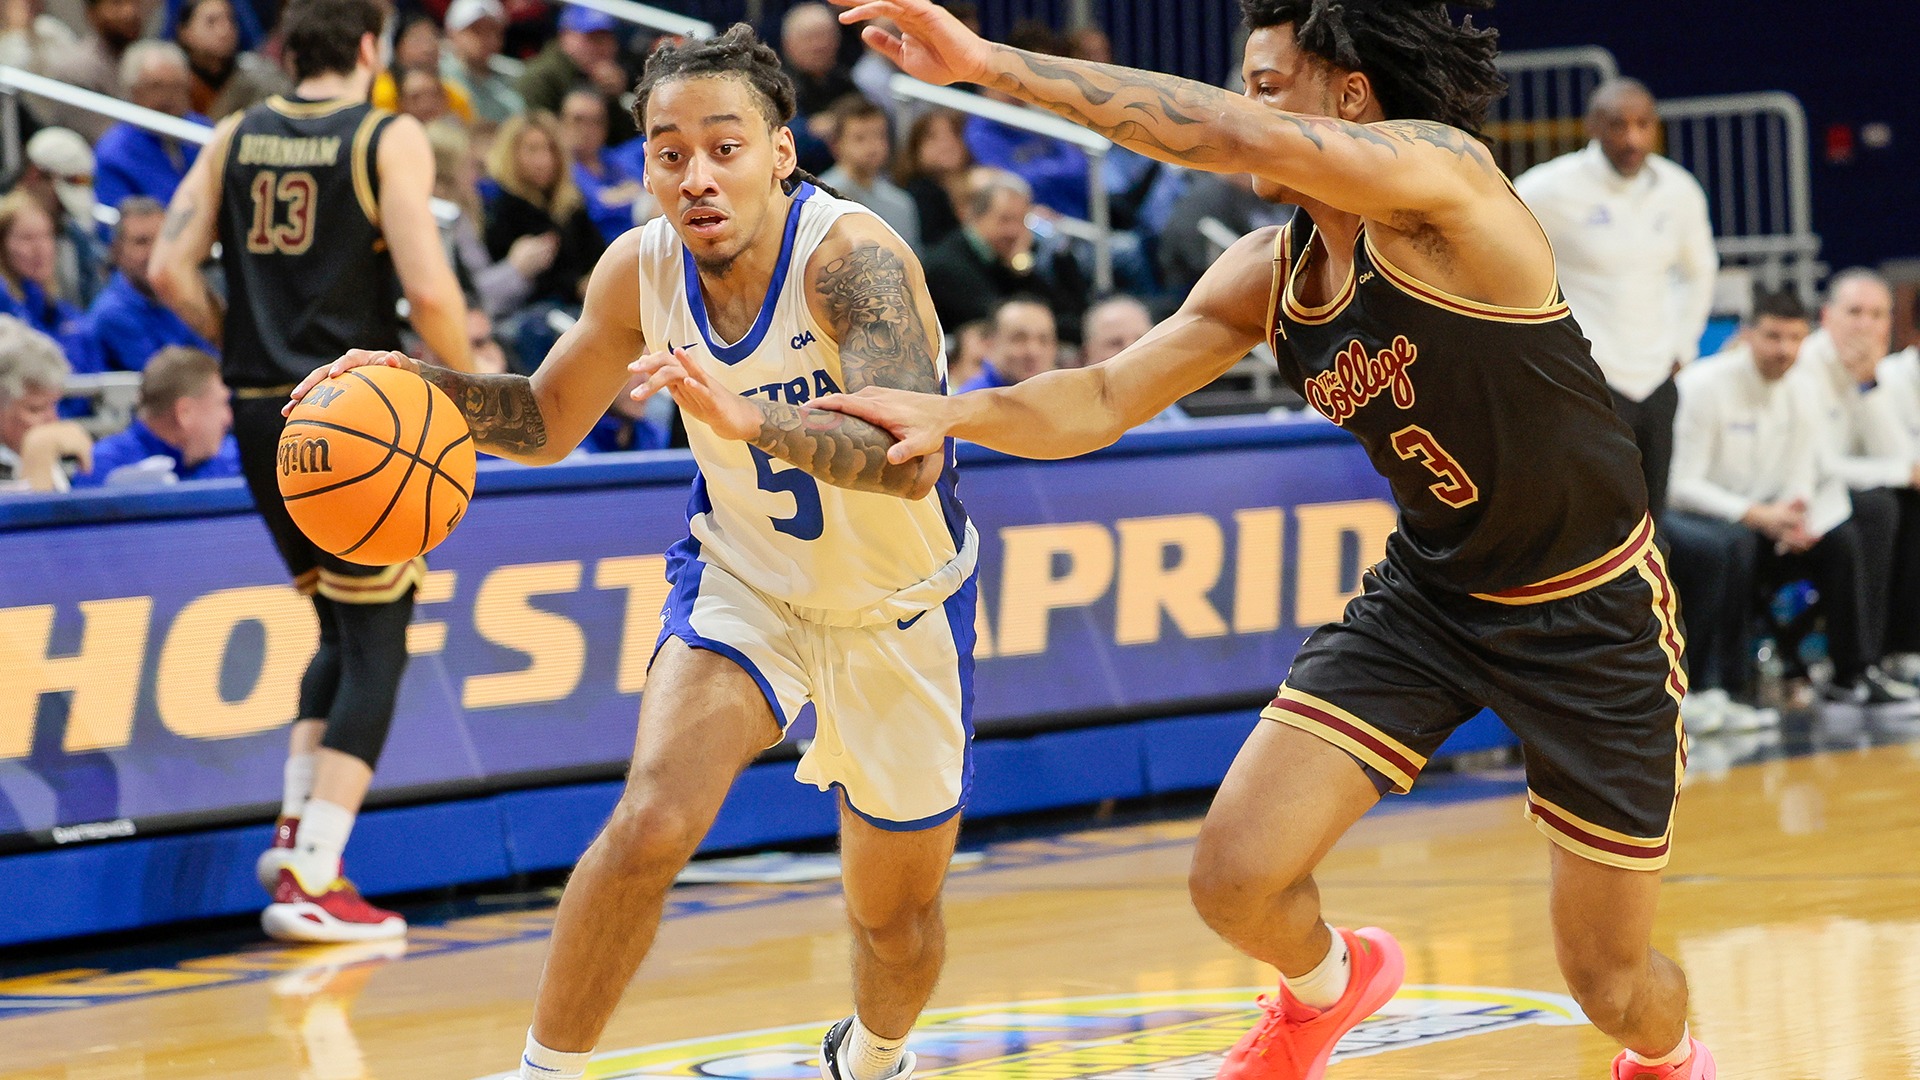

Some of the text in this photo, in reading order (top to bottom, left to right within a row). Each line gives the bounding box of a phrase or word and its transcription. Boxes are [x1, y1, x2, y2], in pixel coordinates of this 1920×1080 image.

[247, 170, 318, 255] 13
[1359, 270, 1375, 284] CAA
[1305, 335, 1417, 426] College
[1318, 370, 1338, 391] The
[747, 443, 825, 541] 5
[1390, 424, 1478, 509] 3
[998, 499, 1398, 657] PRID
